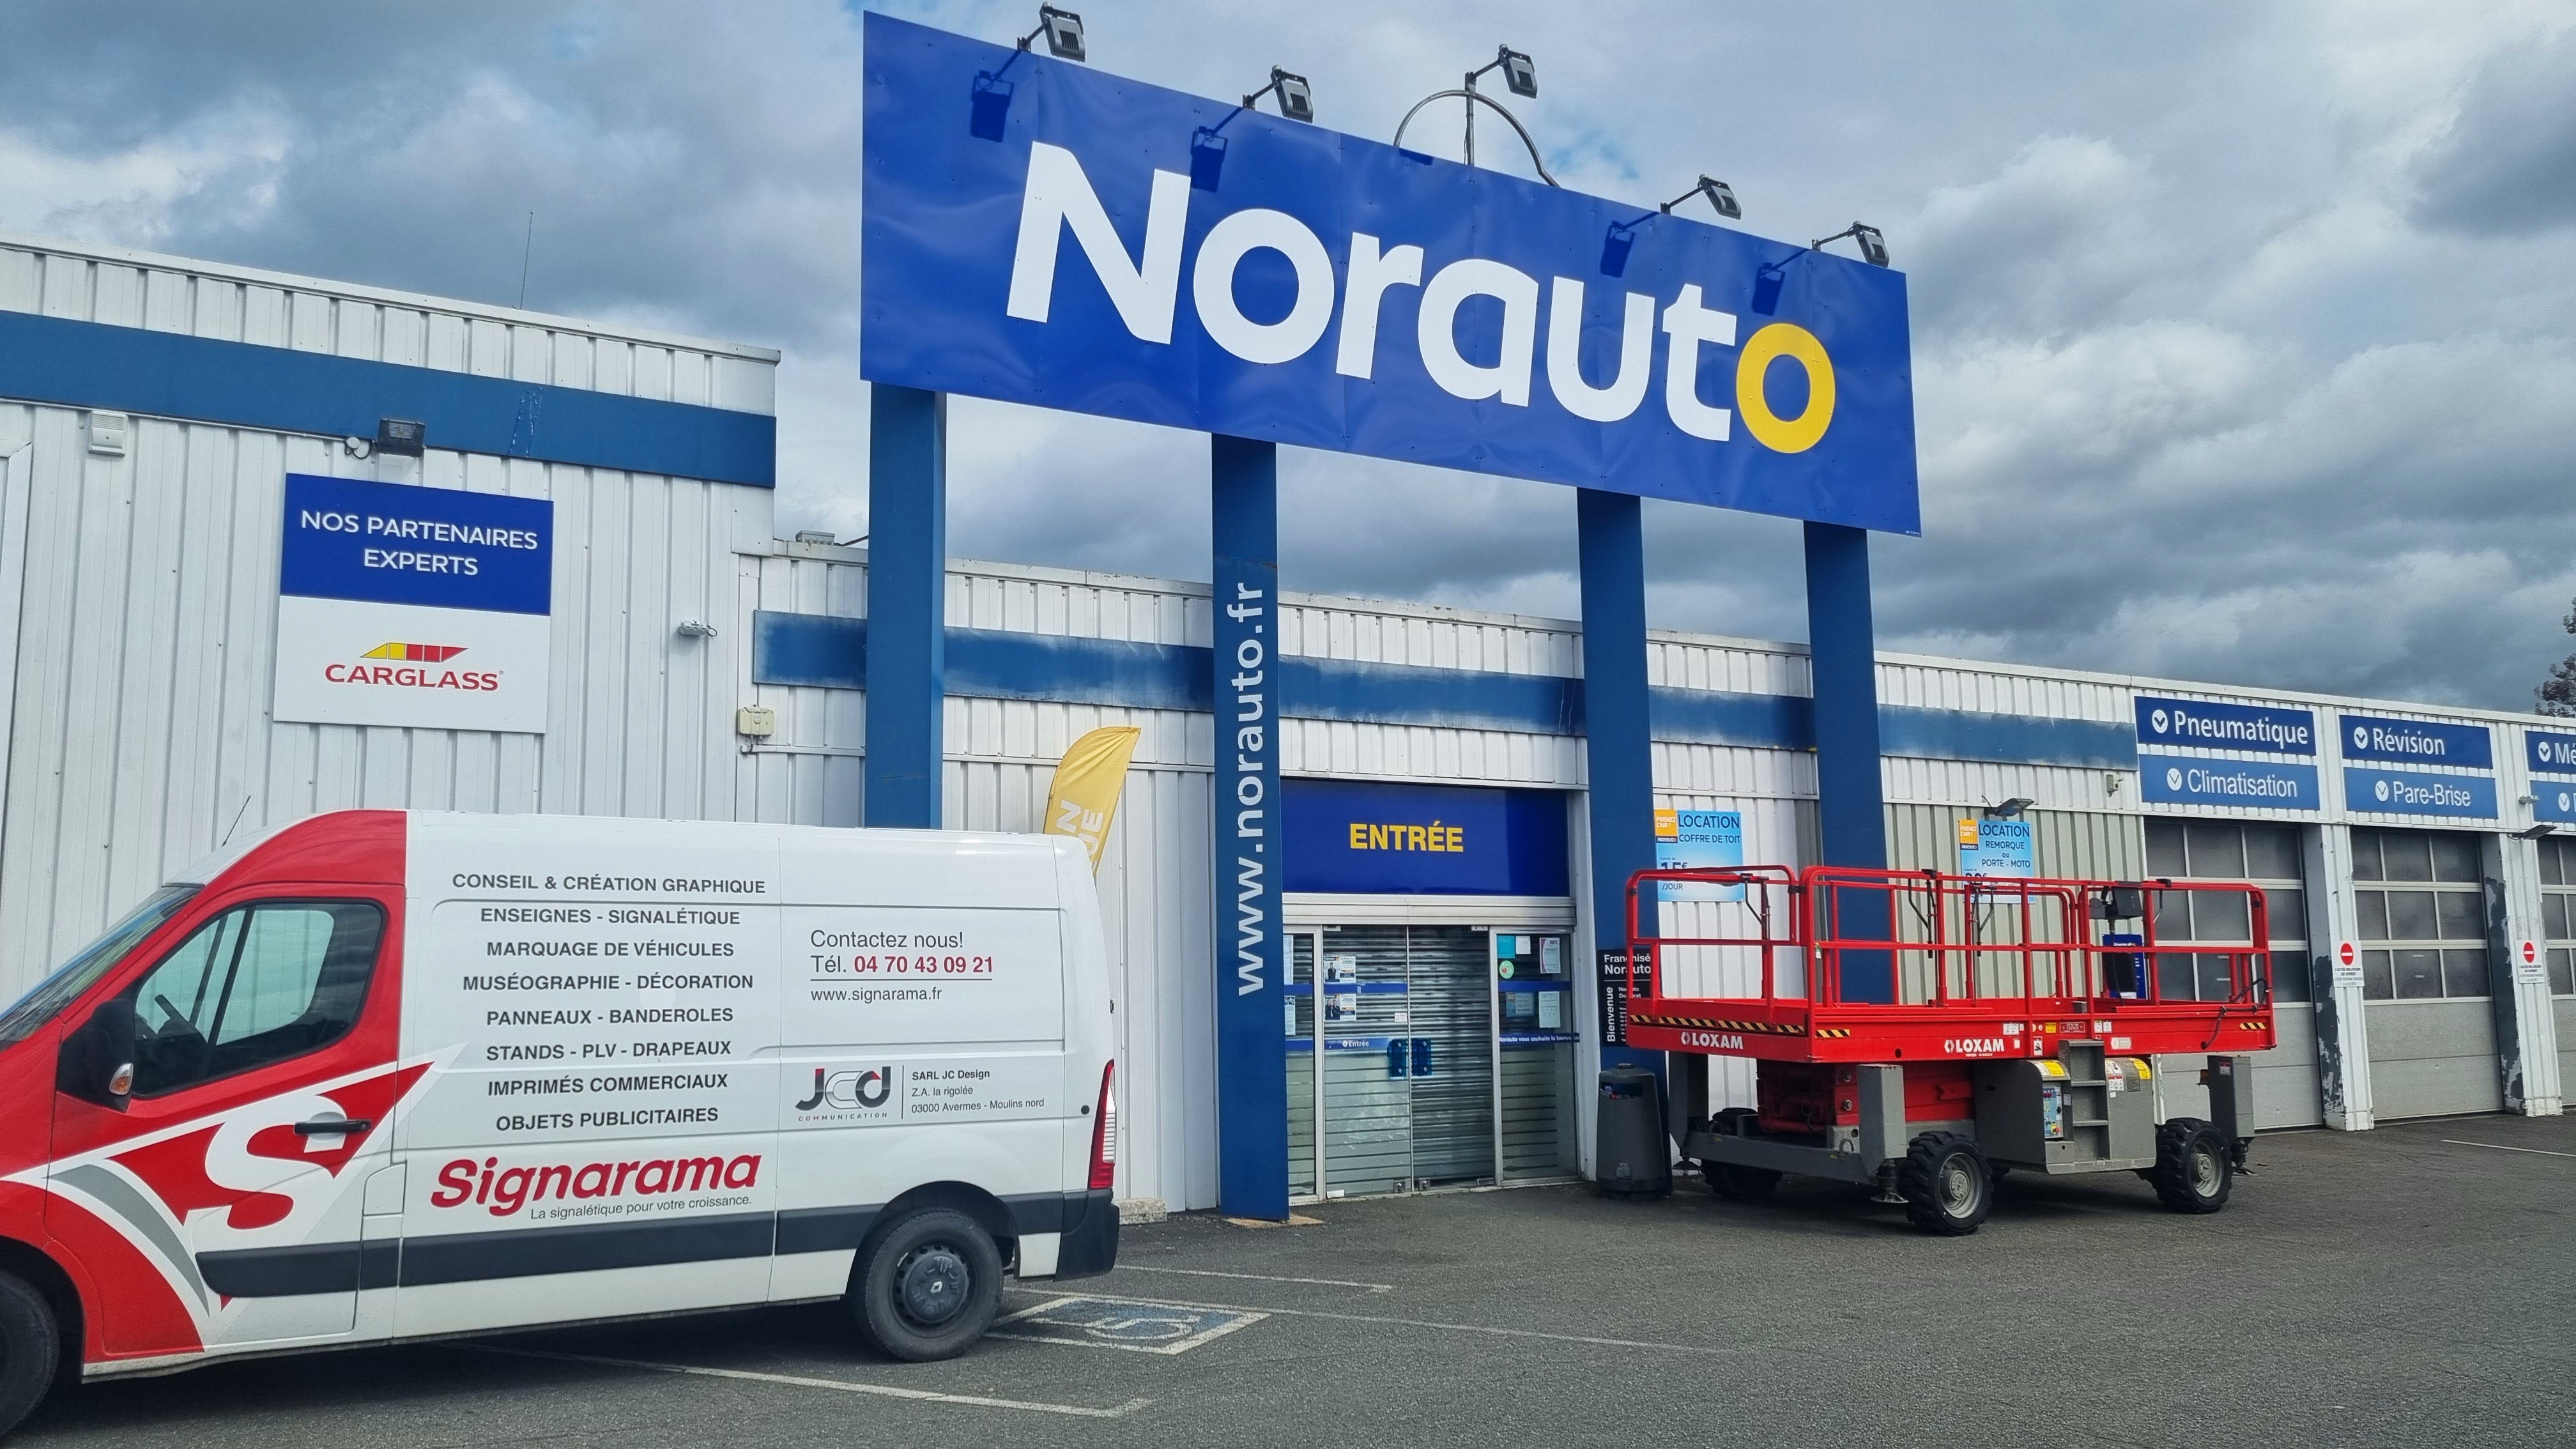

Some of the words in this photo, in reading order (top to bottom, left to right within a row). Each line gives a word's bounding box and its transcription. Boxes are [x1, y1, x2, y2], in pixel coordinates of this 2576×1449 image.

[1006, 141, 1836, 454] Norauto
[302, 511, 359, 532] NOS
[368, 516, 538, 550] PARTENAIRES
[364, 549, 479, 576] EXPERTS
[325, 664, 500, 691] CARGLASS
[2174, 710, 2308, 749] Pneumatique
[2373, 727, 2445, 756] Révision
[1227, 582, 1264, 996] www.norauto.fr
[2188, 769, 2298, 799] Climatisation
[2393, 781, 2471, 807] Pare-Brise
[1678, 815, 1740, 829] LOCATION
[1979, 824, 2030, 838] LOCATION
[1350, 820, 1464, 852] ENTRÉE
[1679, 834, 1710, 843] COFFRE
[1712, 834, 1722, 843] DE
[1724, 835, 1741, 843] TOIT
[1986, 841, 2025, 850] REMORQUE
[2011, 860, 2030, 868] MOTO
[452, 873, 538, 889] CONSEIL
[545, 877, 557, 889] &
[564, 873, 656, 892] CRÉATION
[663, 878, 765, 894] GRAPHIQUE
[481, 908, 591, 924] ENSEIGNES
[608, 907, 740, 926] SIGNALÉTIQUE
[487, 942, 598, 958] MARQUAGE
[604, 942, 629, 956] DE
[634, 939, 733, 956] VÉHICULES
[811, 929, 908, 949] Contactez
[914, 931, 963, 949] nous!
[811, 954, 847, 974] Tél.
[854, 955, 878, 974] 04
[885, 956, 908, 974] 70
[914, 956, 937, 974] 43
[944, 956, 967, 974] 09
[972, 956, 993, 973] 21
[463, 972, 620, 992] MUSÉOGRAPHIE
[637, 971, 753, 990] DÉCORATION
[811, 987, 942, 1004] www.signarama.fr
[487, 1010, 592, 1025] PANNEAUX
[610, 1008, 733, 1023] BANDEROLES
[1606, 986, 1616, 1042] Bienvenue
[487, 1045, 564, 1061] STANDS
[583, 1044, 617, 1059] PLV
[632, 1041, 732, 1057] DRAPEAUX
[1692, 1033, 1744, 1049] LOXAM
[1956, 1038, 2004, 1053] LOXAM
[489, 1075, 584, 1096] IMPRIMÉS
[590, 1073, 728, 1092] COMMERCIAUX
[912, 1071, 939, 1081] SARL
[942, 1070, 954, 1080] JC
[958, 1069, 990, 1081] Design
[912, 1087, 930, 1097] Z.A.
[933, 1086, 941, 1095] la
[944, 1085, 973, 1096] rigolée
[911, 1103, 940, 1113] 03000
[942, 1101, 981, 1112] Avermes
[990, 1100, 1023, 1110] Moulins
[1025, 1098, 1044, 1108] nord
[496, 1114, 573, 1131] OBJETS
[580, 1108, 718, 1128] PUBLICITAIRES
[798, 1112, 887, 1122] COMMUNICATION
[431, 1154, 762, 1217] Signarama
[531, 1209, 546, 1220] La
[550, 1204, 623, 1220] signalétique
[626, 1202, 653, 1216] pour
[657, 1200, 685, 1211] votre
[689, 1195, 752, 1208] croissance.
